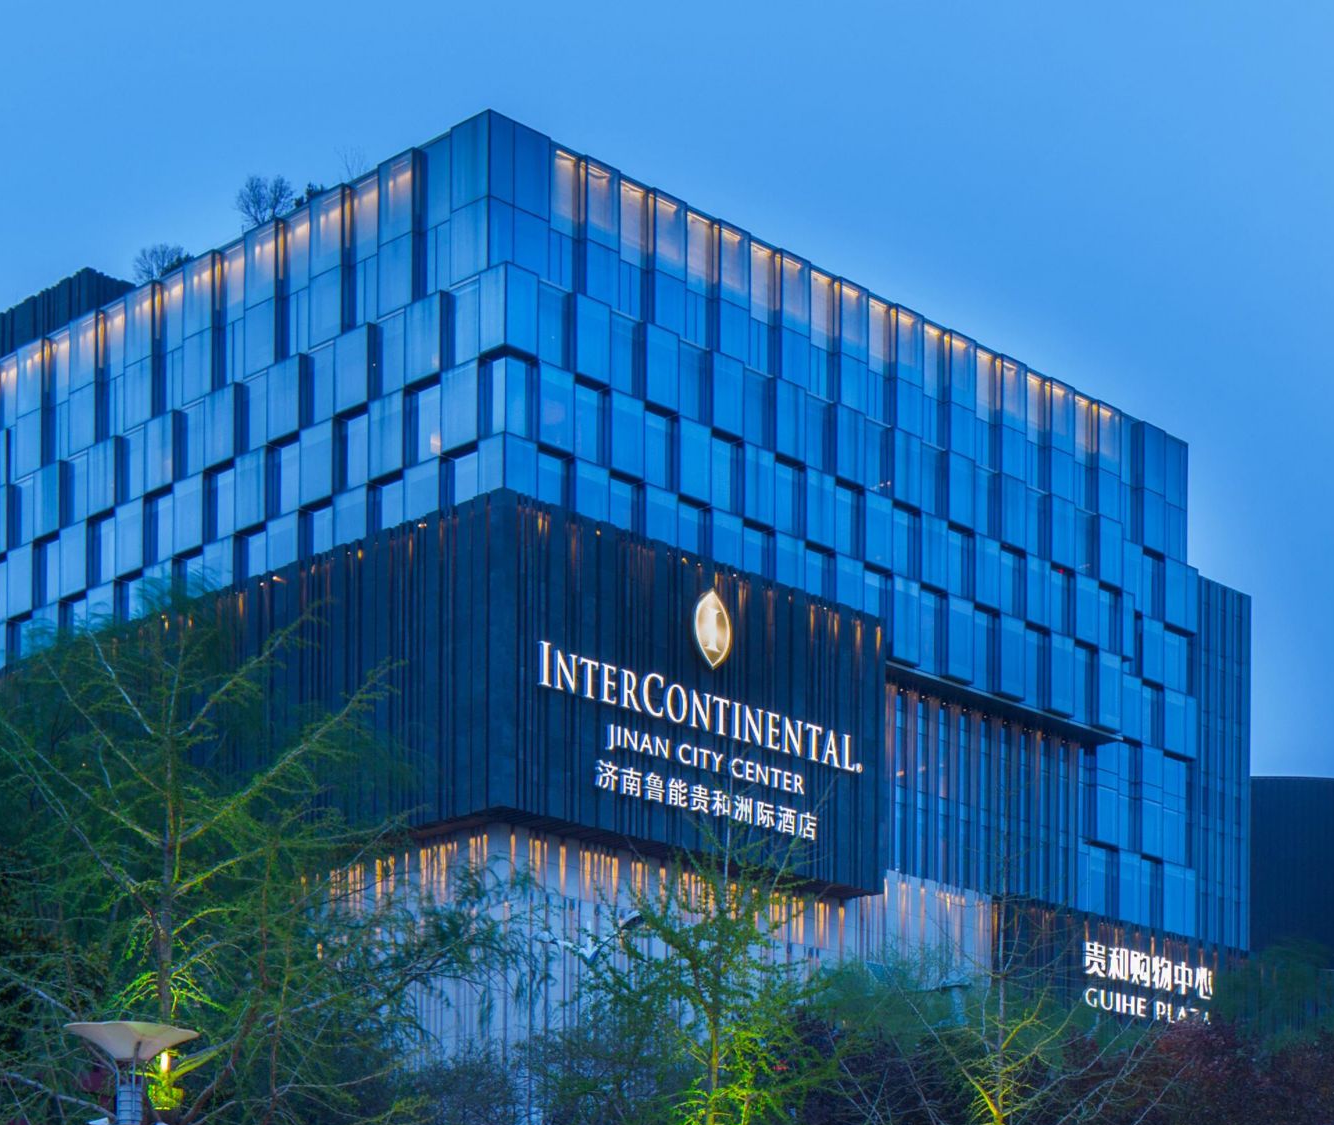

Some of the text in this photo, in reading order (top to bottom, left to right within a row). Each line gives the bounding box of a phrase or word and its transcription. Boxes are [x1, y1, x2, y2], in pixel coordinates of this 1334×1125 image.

[604, 723, 805, 795] JINAN CITY CENTER
[594, 759, 818, 842] 济南鲁能贵和洲际酒店
[1084, 941, 1214, 1000] 贵和购物中心
[1084, 987, 1147, 1018] GUIHE
